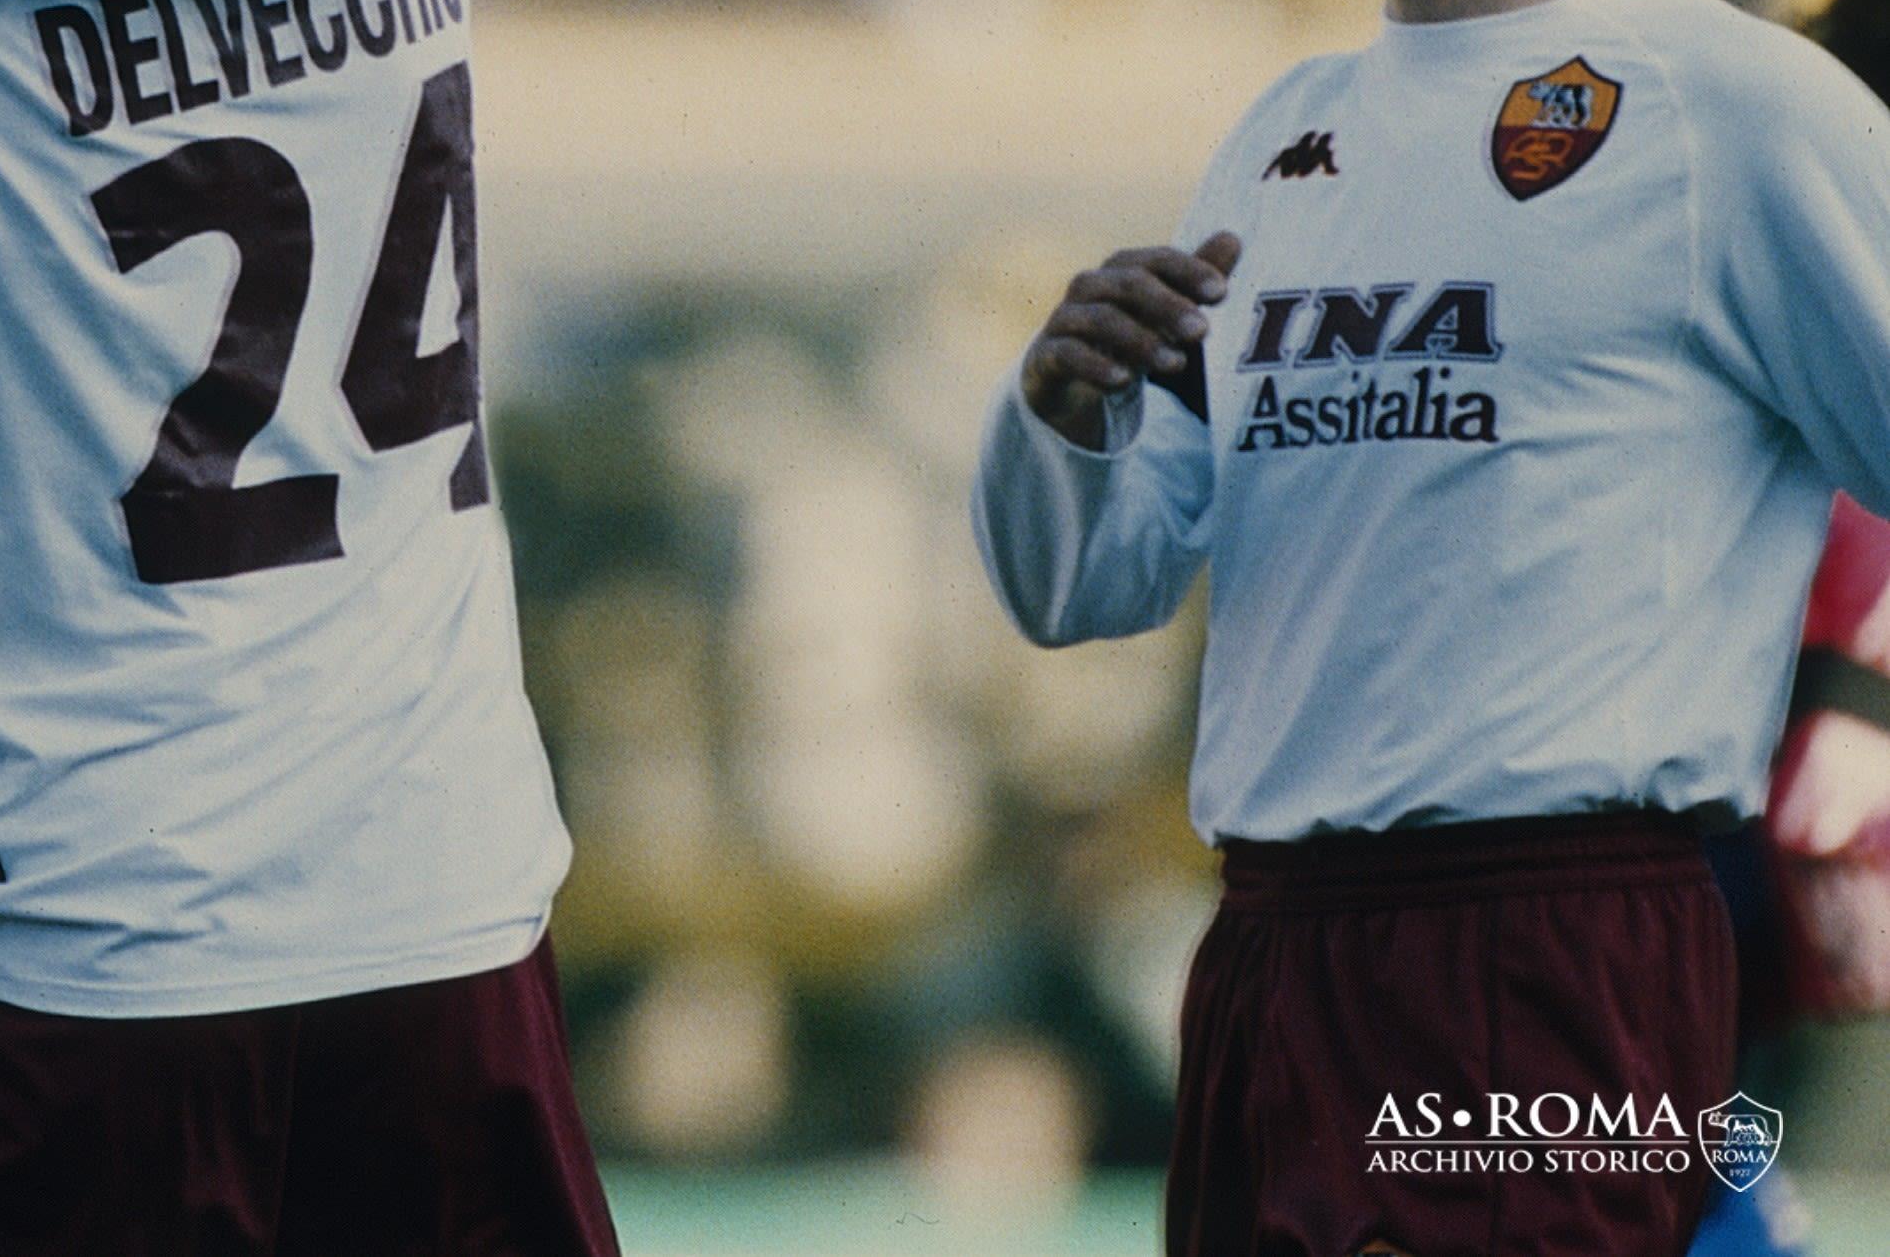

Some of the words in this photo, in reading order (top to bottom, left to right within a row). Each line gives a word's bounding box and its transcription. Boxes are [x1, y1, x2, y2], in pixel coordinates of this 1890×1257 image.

[90, 61, 490, 584] 24
[1238, 281, 1503, 372] INA
[1237, 367, 1501, 452] Assitalia
